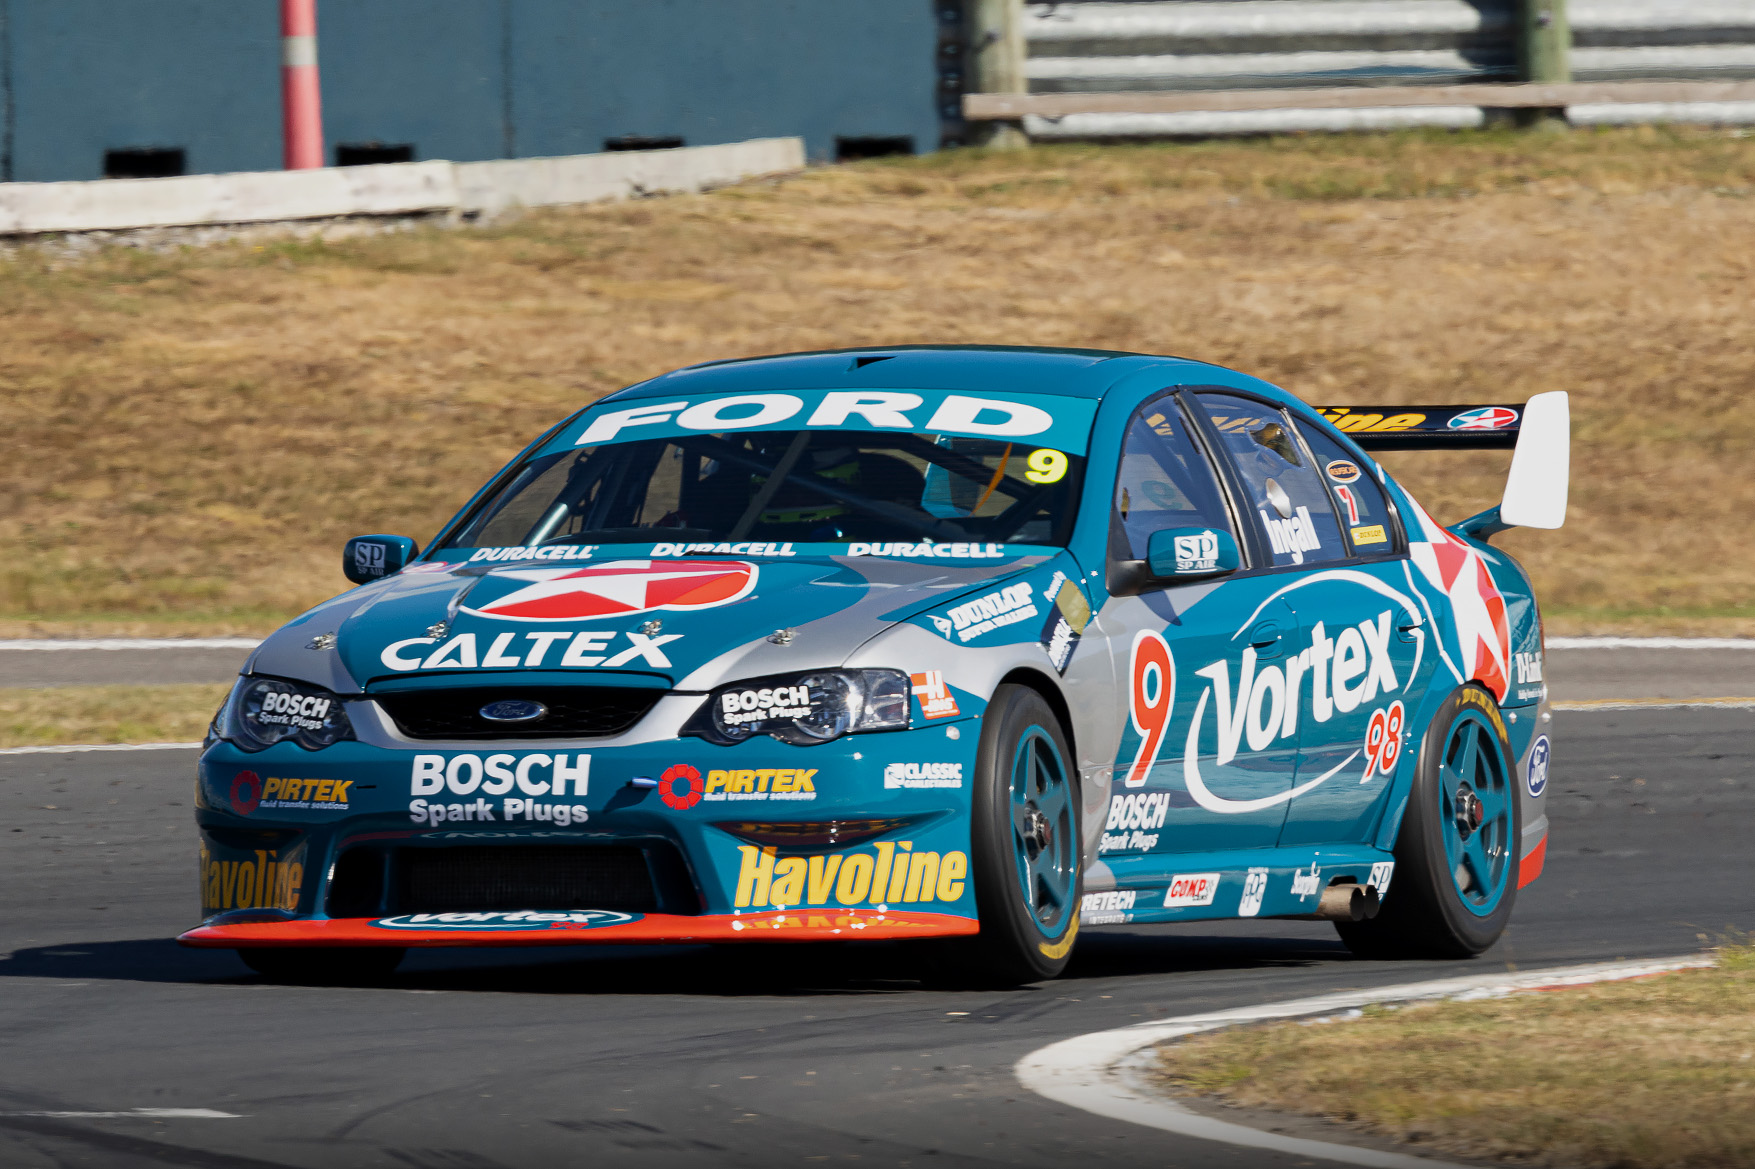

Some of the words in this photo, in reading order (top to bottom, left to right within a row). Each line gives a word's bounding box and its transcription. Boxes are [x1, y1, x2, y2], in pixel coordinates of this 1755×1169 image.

[575, 391, 1053, 445] FORD
[1025, 448, 1069, 484] 9
[1260, 506, 1322, 565] Ingall
[356, 543, 384, 567] SP
[468, 544, 599, 562] DURACELL
[650, 542, 797, 558] DURACELL
[847, 542, 1004, 558] DURACELL
[1179, 538, 1214, 560] SP
[946, 581, 1033, 630] DUNLOP
[380, 631, 685, 671] CALTEX
[721, 685, 809, 713] BOSCH
[1194, 609, 1399, 766] Vortex
[262, 692, 331, 718] BOSCH
[723, 709, 768, 725] Spark
[769, 706, 812, 718] Plugs
[1125, 629, 1176, 787] 9
[259, 711, 289, 724] Spark
[291, 715, 322, 730] Plugs
[1359, 700, 1405, 784] 98
[411, 754, 592, 796] BOSCH
[704, 768, 819, 793] PIRTEK
[904, 763, 962, 779] CLASSIC
[261, 777, 354, 803] PIRTEK
[769, 791, 817, 801] solutions
[310, 801, 349, 810] solutions
[409, 798, 496, 827] Spark
[503, 798, 589, 826] Plugs
[1105, 792, 1171, 830] BOSCH
[1098, 832, 1130, 853] Spark
[1128, 830, 1159, 852] Plugs
[734, 841, 967, 907] Havoline
[1170, 879, 1207, 898] COMP
